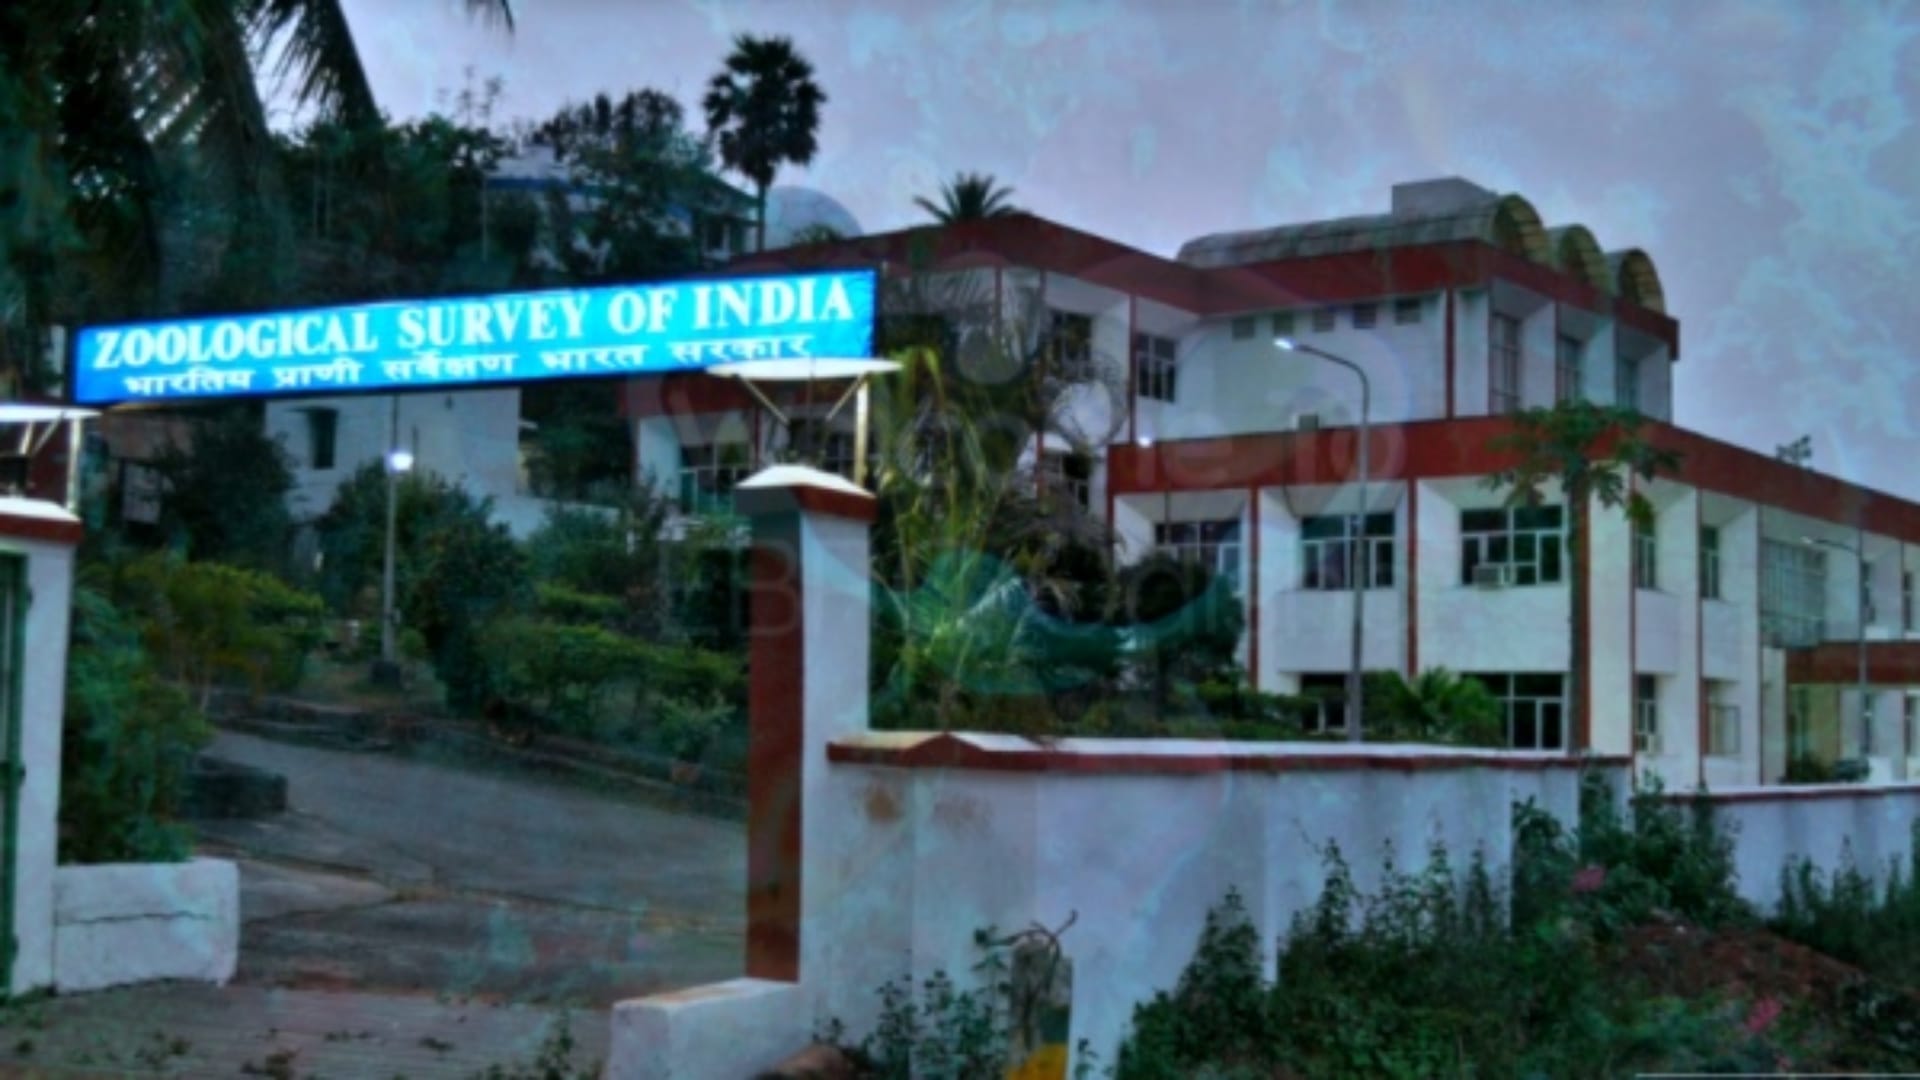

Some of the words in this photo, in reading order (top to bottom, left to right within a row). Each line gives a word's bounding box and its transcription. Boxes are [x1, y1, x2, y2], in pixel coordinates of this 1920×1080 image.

[93, 312, 378, 369] ZOOLOGICAL
[398, 294, 590, 349] SURVEY
[607, 286, 680, 335] OF
[693, 278, 855, 330] INDIA
[273, 357, 365, 388] प्राणी
[539, 343, 651, 372] भारत
[668, 333, 816, 364] सरकार
